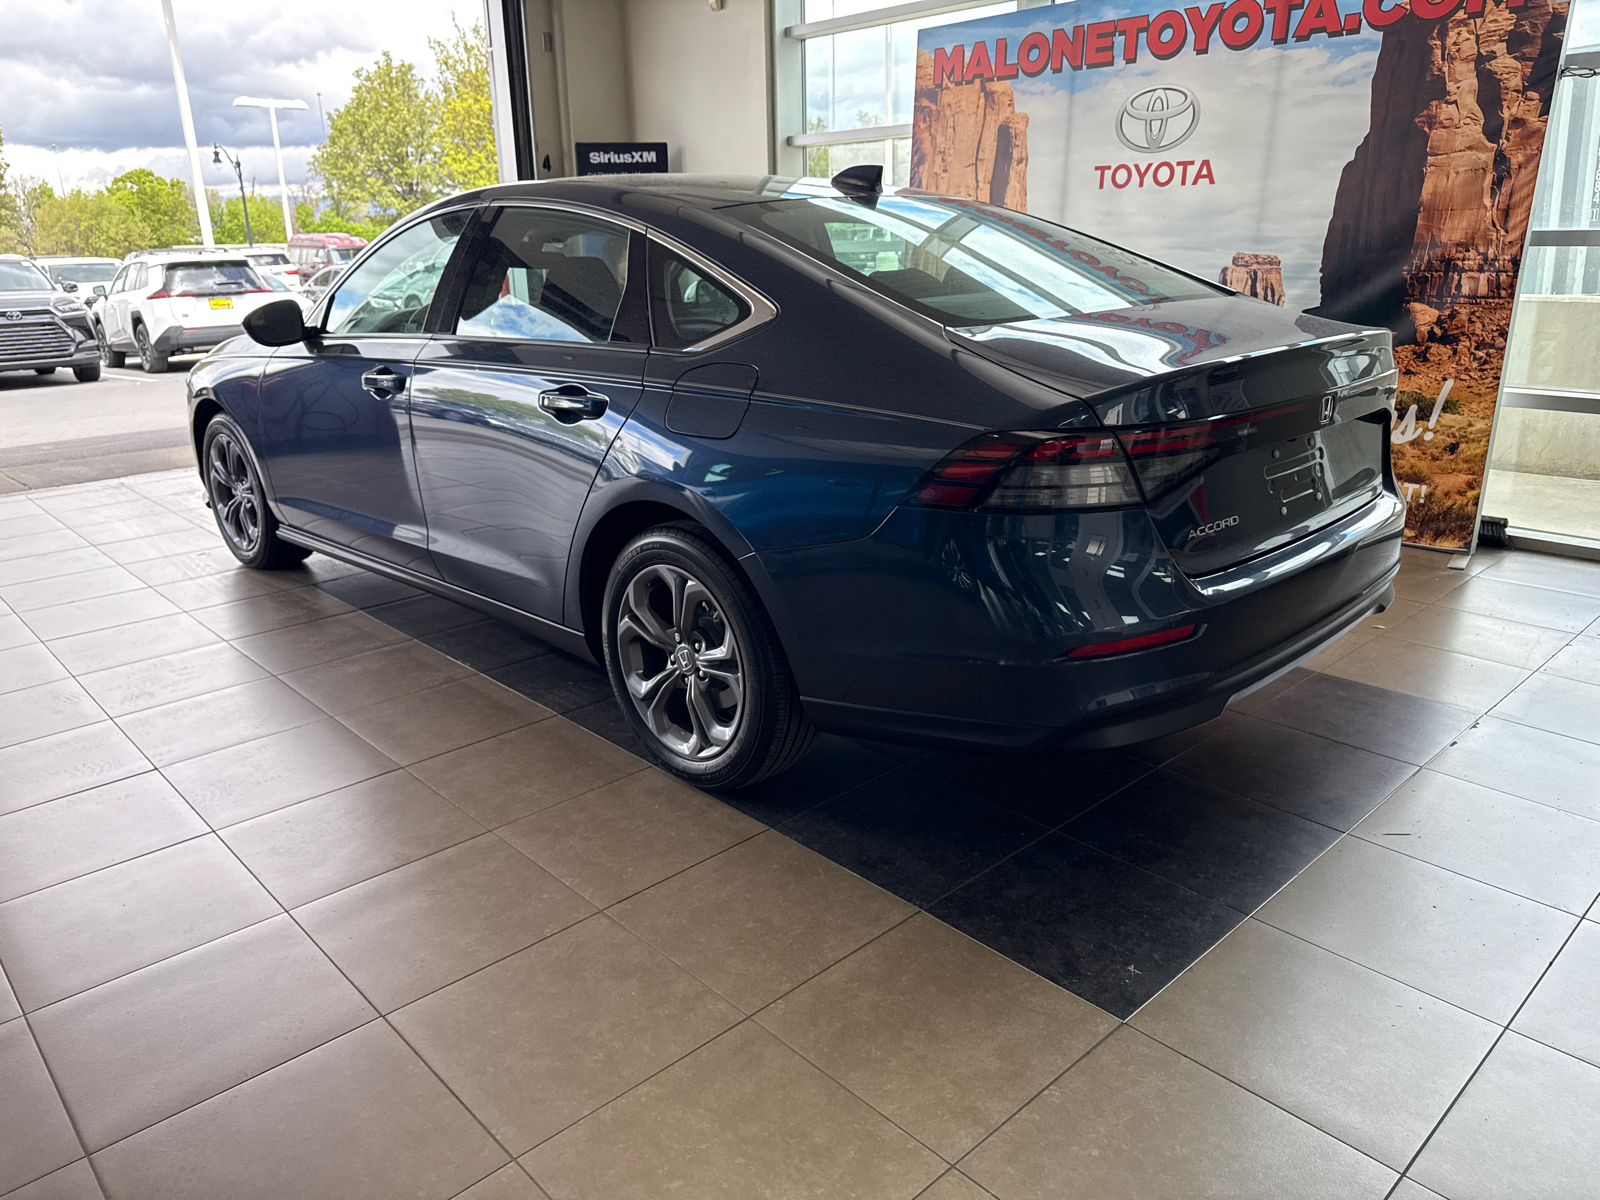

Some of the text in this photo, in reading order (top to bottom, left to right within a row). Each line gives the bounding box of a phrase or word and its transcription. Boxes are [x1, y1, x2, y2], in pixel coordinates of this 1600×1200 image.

[543, 154, 551, 172] 4
[589, 151, 657, 164] SiriusXM
[1094, 159, 1216, 190] TOYOTA
[1187, 515, 1240, 540] ACCORD
